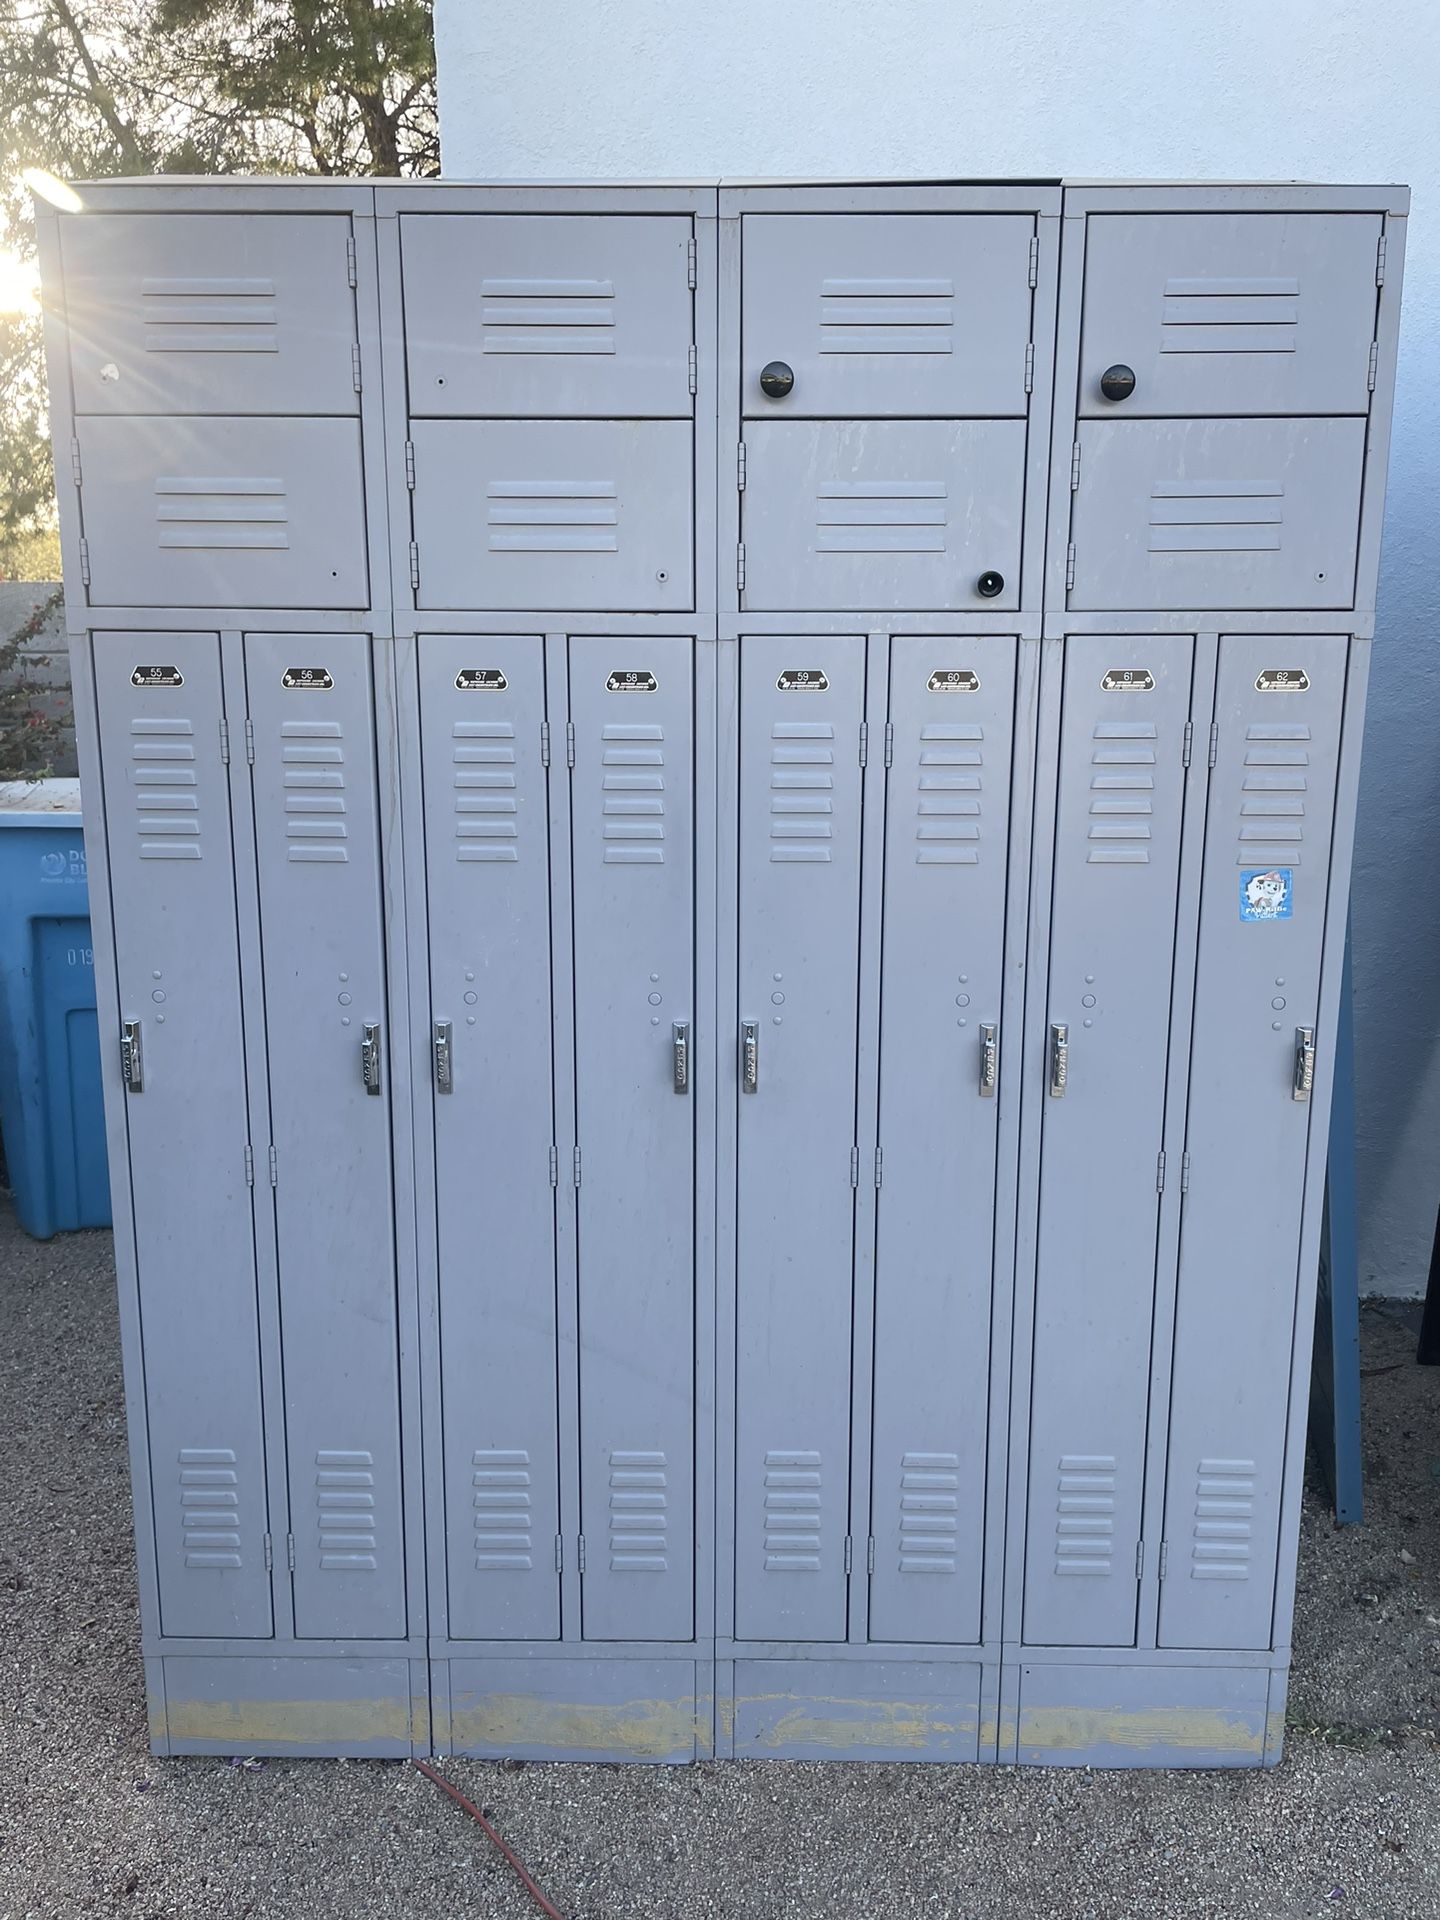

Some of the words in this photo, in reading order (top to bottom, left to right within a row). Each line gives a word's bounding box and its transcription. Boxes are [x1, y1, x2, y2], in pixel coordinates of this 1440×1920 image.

[150, 668, 162, 677] 55
[301, 670, 313, 680] 56
[475, 671, 487, 680] 57
[797, 672, 809, 681] 59
[947, 672, 960, 682] 60
[1123, 672, 1133, 681] 61
[1276, 672, 1289, 681] 62
[625, 673, 638, 682] 58
